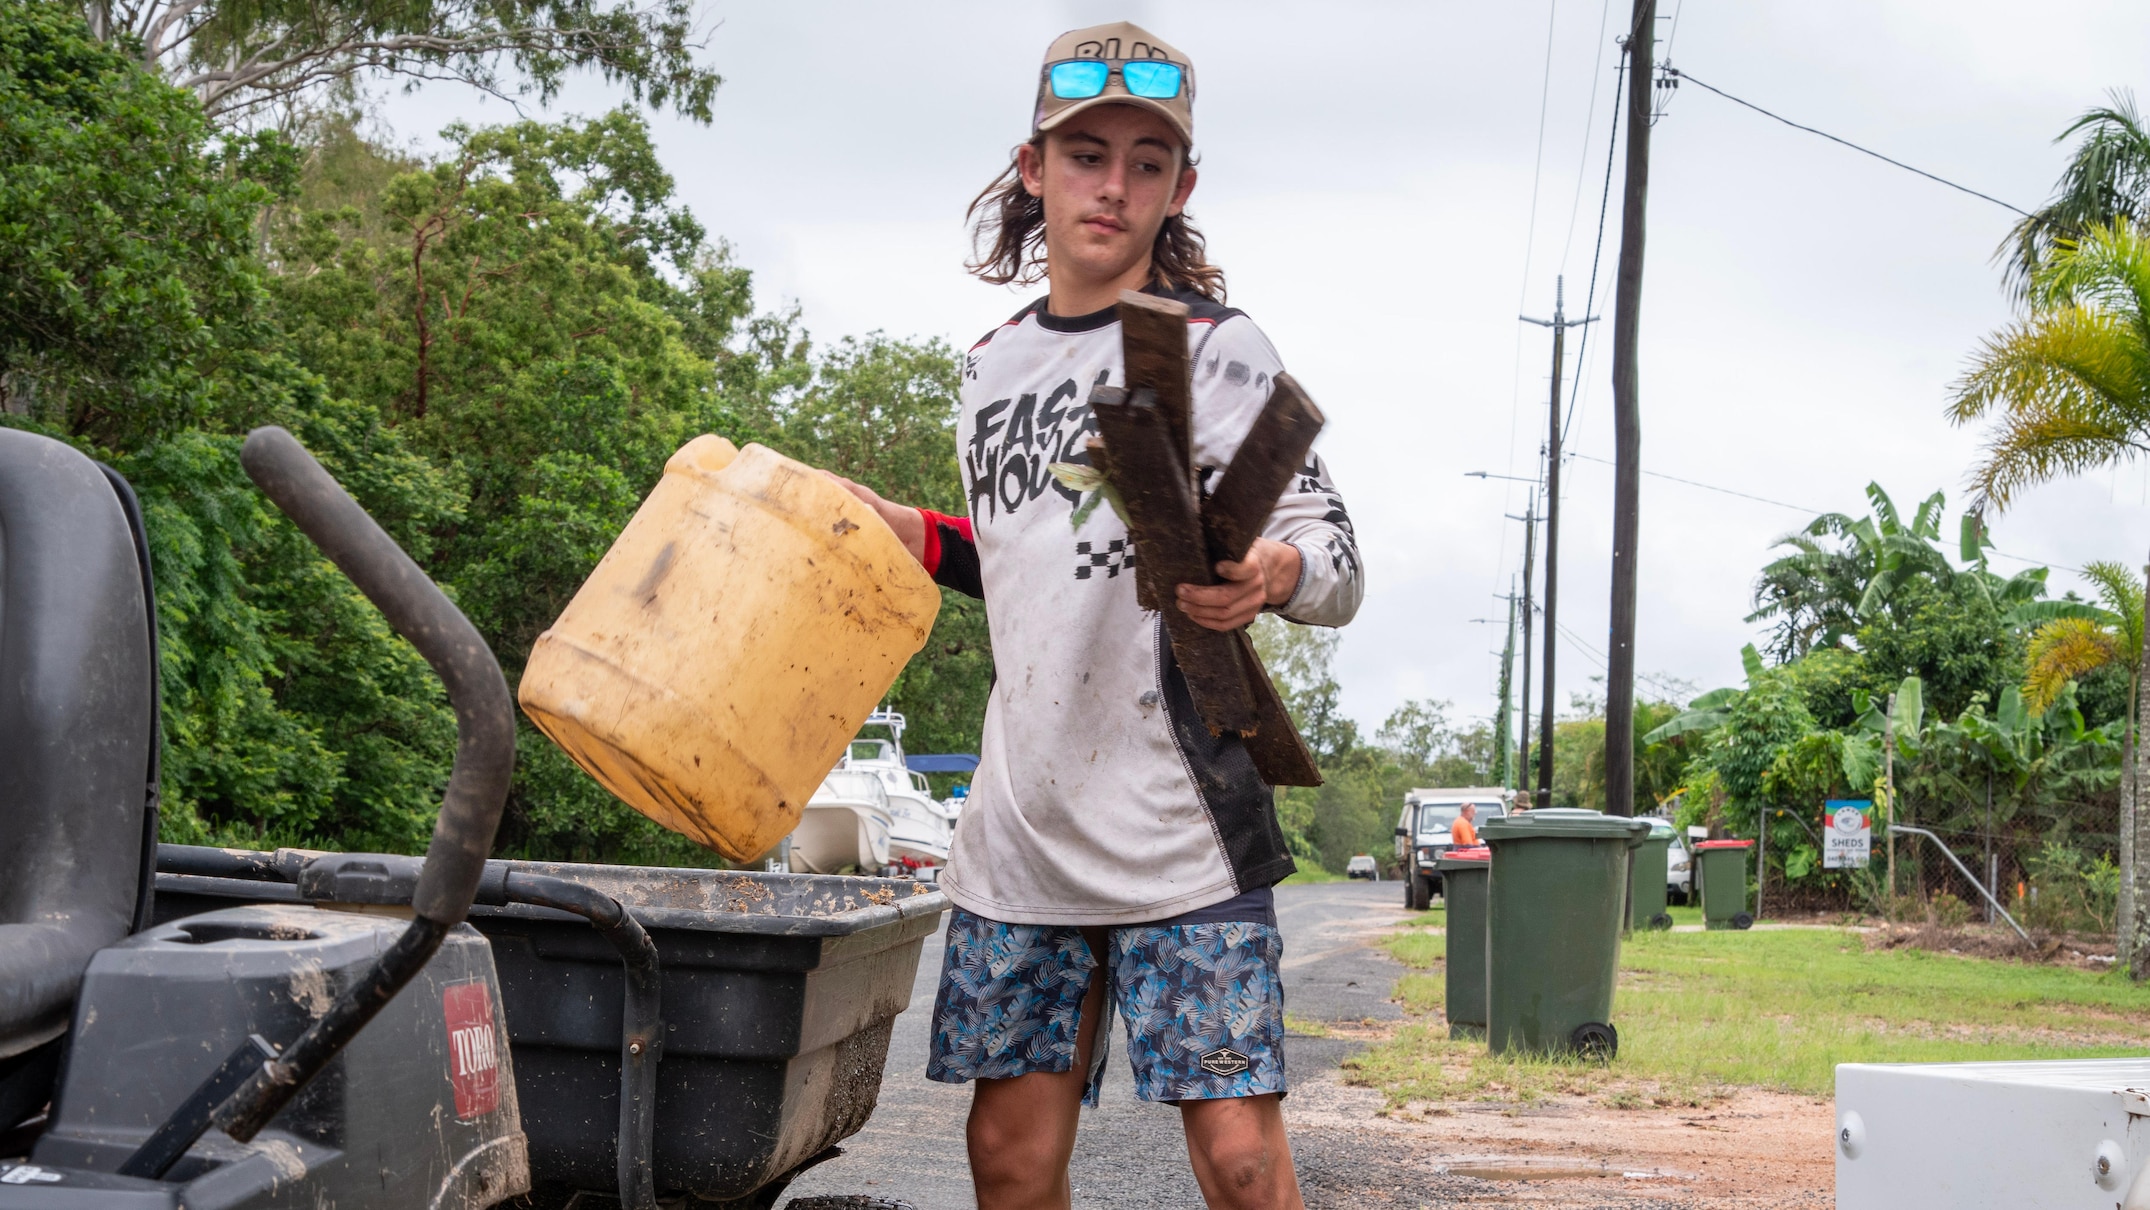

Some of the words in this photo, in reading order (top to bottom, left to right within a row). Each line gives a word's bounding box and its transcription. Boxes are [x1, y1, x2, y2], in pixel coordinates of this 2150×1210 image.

[966, 424, 1097, 540] HOUS
[1832, 838, 1864, 847] SHEDS
[452, 1024, 495, 1076] TORO
